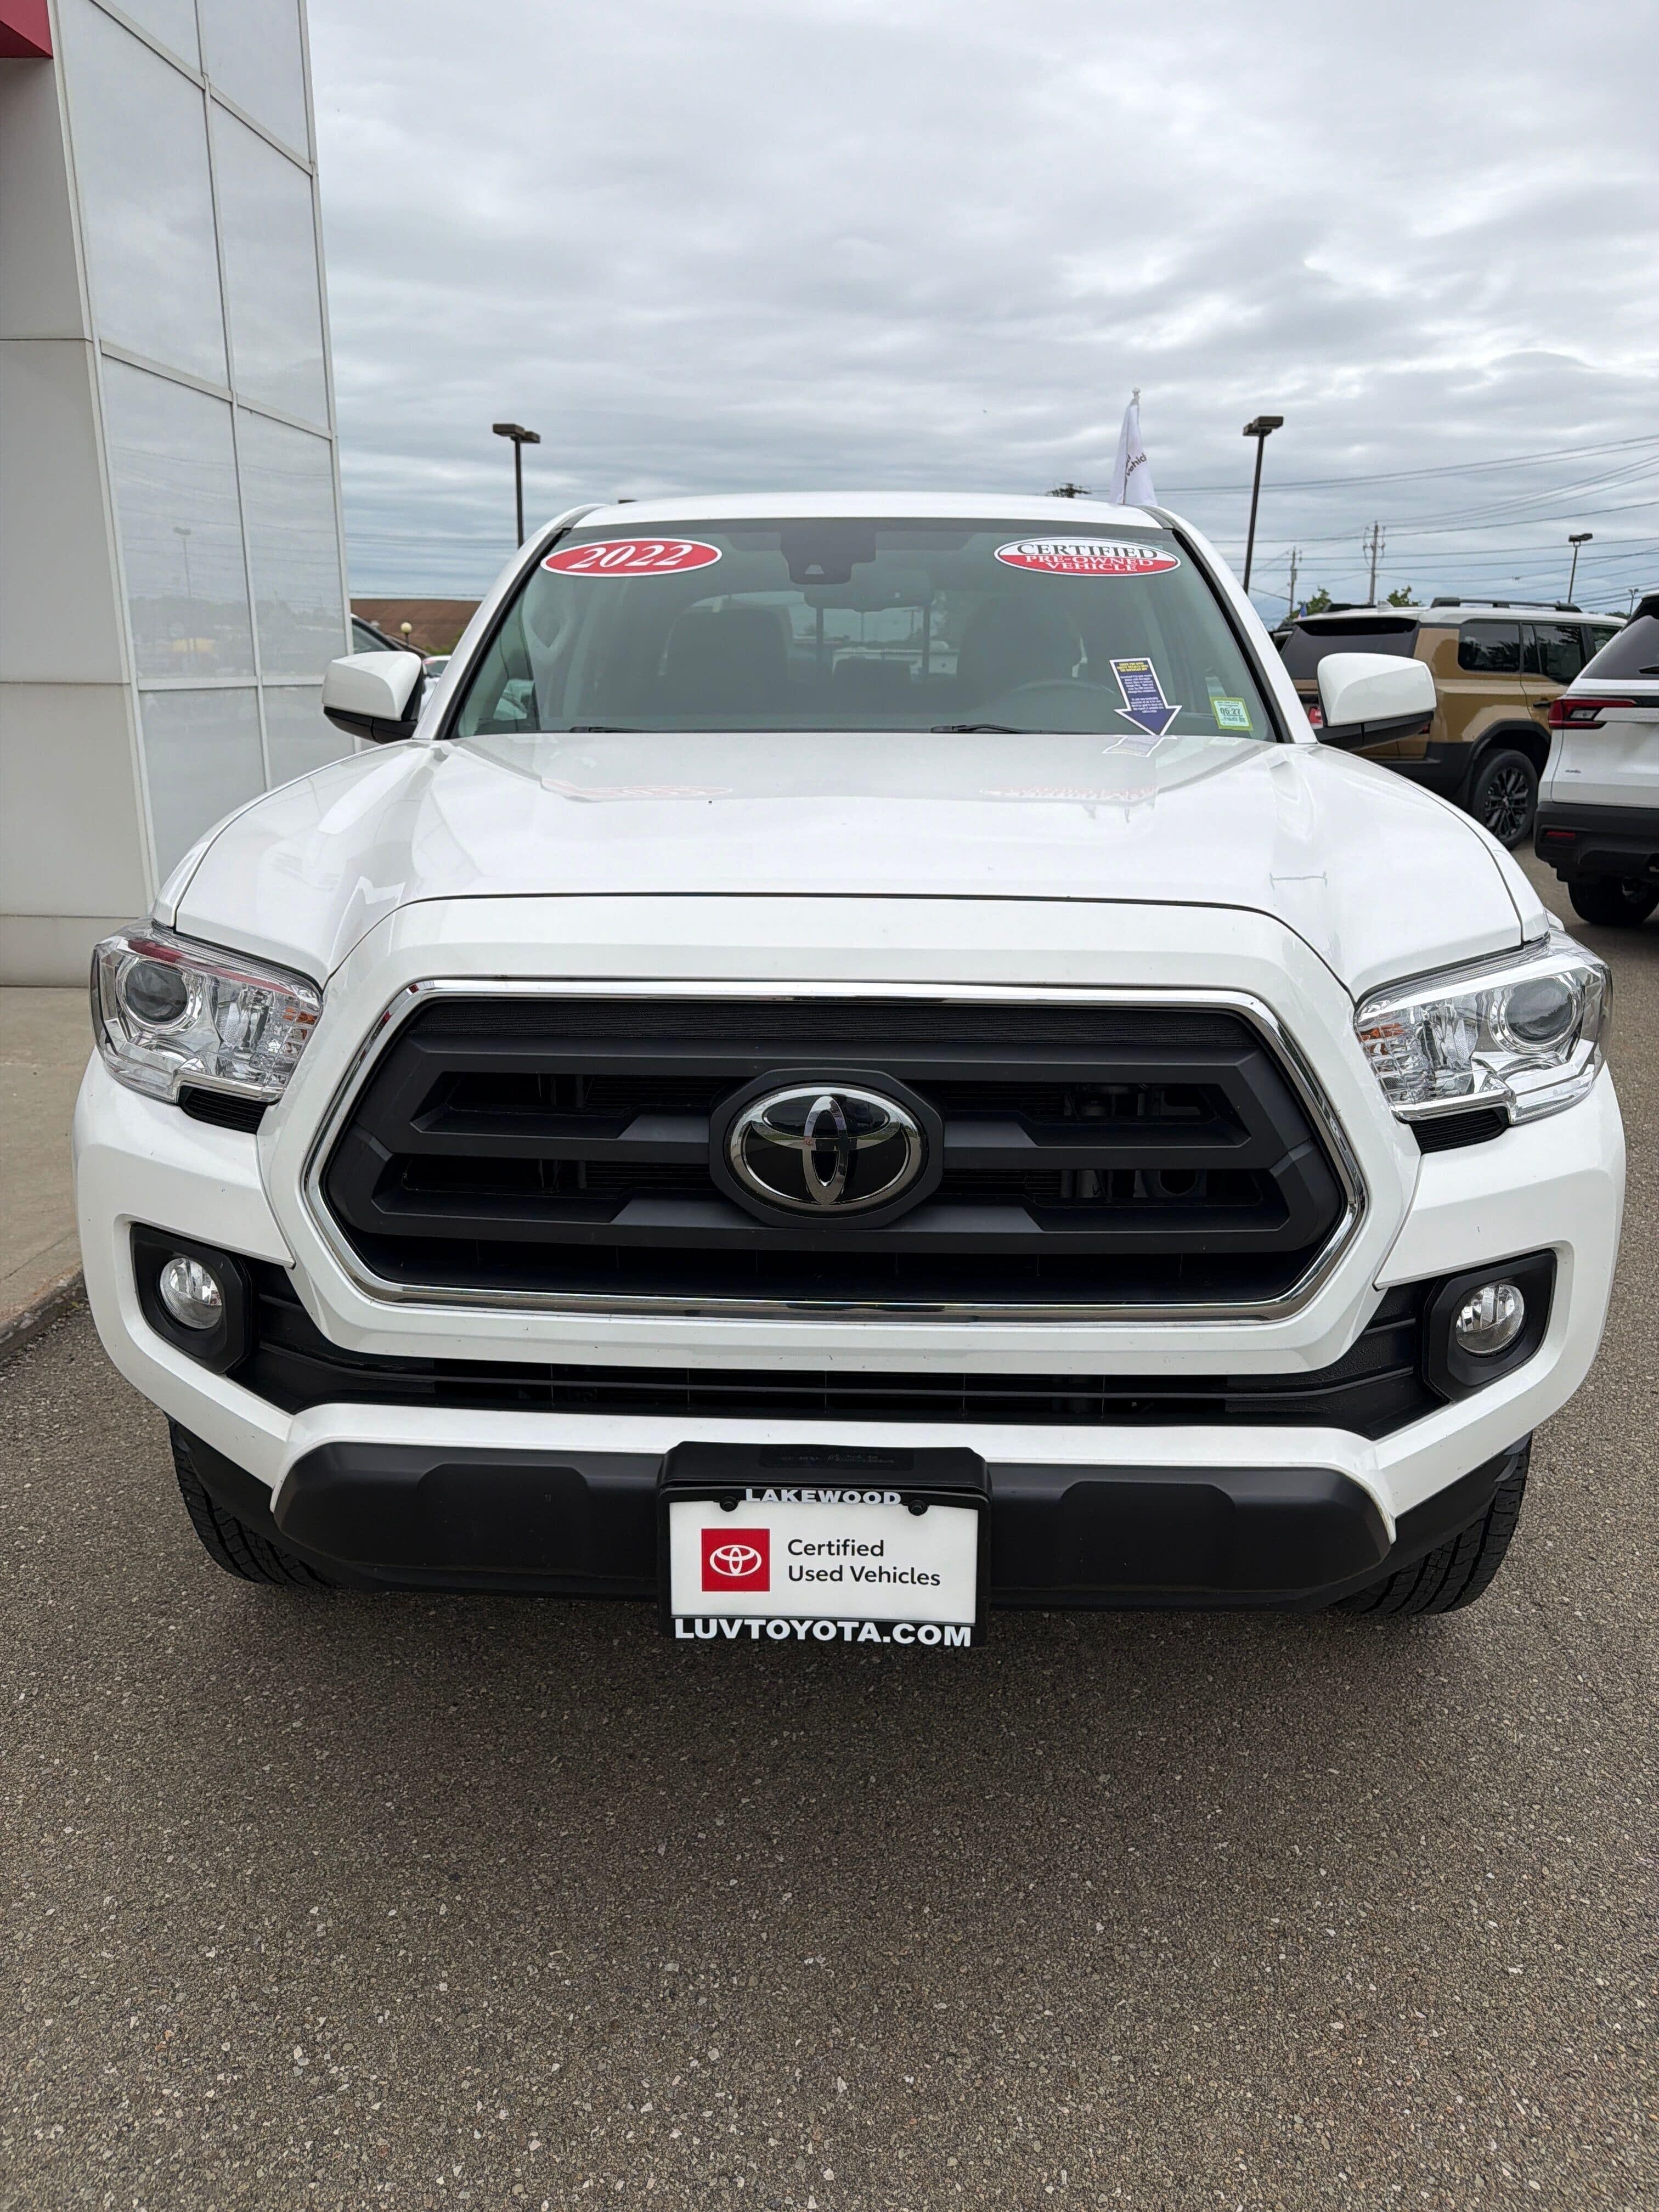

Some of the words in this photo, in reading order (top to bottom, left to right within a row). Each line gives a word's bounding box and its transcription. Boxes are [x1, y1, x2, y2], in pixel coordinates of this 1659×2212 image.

[566, 544, 693, 569] 2022
[1017, 544, 1158, 559] CERTIFIED
[1025, 555, 1154, 567] PRE-OWNED
[1044, 562, 1138, 572] VEHICLE
[745, 1488, 901, 1505] LAKEWOOD
[787, 1538, 884, 1557] Certified
[788, 1564, 843, 1582] Used
[850, 1565, 941, 1586] Vehicles
[675, 1618, 972, 1647] LUVTOYOTA.COM
